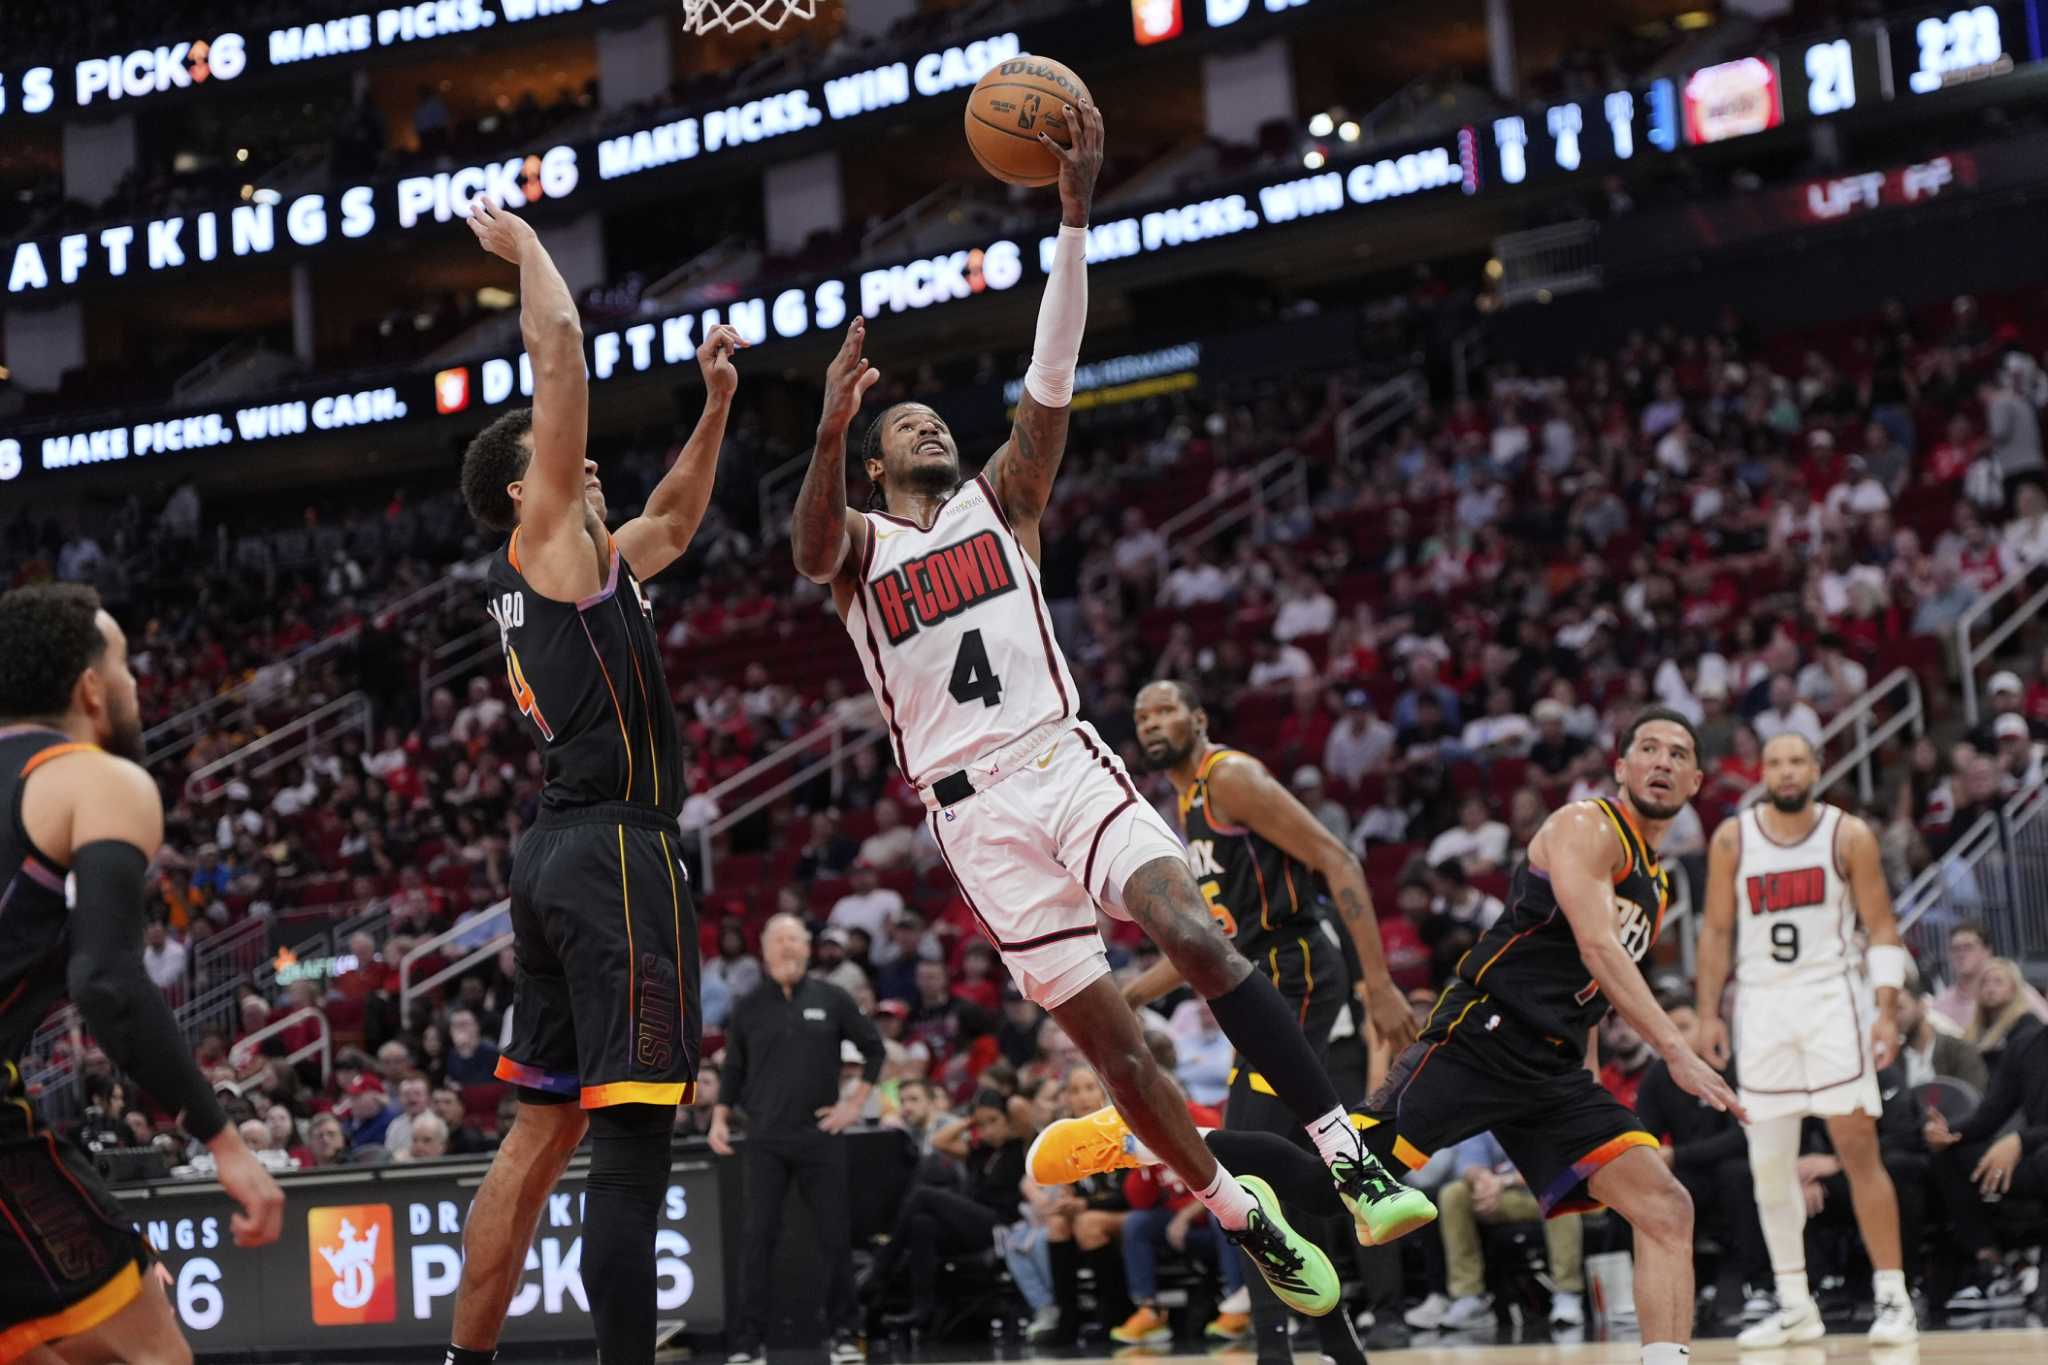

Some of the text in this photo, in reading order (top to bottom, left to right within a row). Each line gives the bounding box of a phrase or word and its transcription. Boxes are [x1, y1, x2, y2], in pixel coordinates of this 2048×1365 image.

[269, 14, 371, 65] MAKE
[376, 0, 496, 45] PICKS.
[598, 117, 699, 180] MAKE
[703, 89, 823, 152] PICKS.
[823, 62, 910, 120] WIN
[914, 32, 1030, 96] CASH
[1000, 60, 1084, 98] Wilson
[1259, 172, 1343, 223] WIN
[41, 427, 128, 469] MAKE
[133, 413, 232, 455] PICKS.
[236, 402, 306, 440] WIN
[312, 387, 407, 430] CASH.
[949, 628, 1002, 708] 4
[1771, 922, 1799, 963] 9
[133, 1217, 218, 1250] NGS
[177, 1257, 224, 1330] 6
